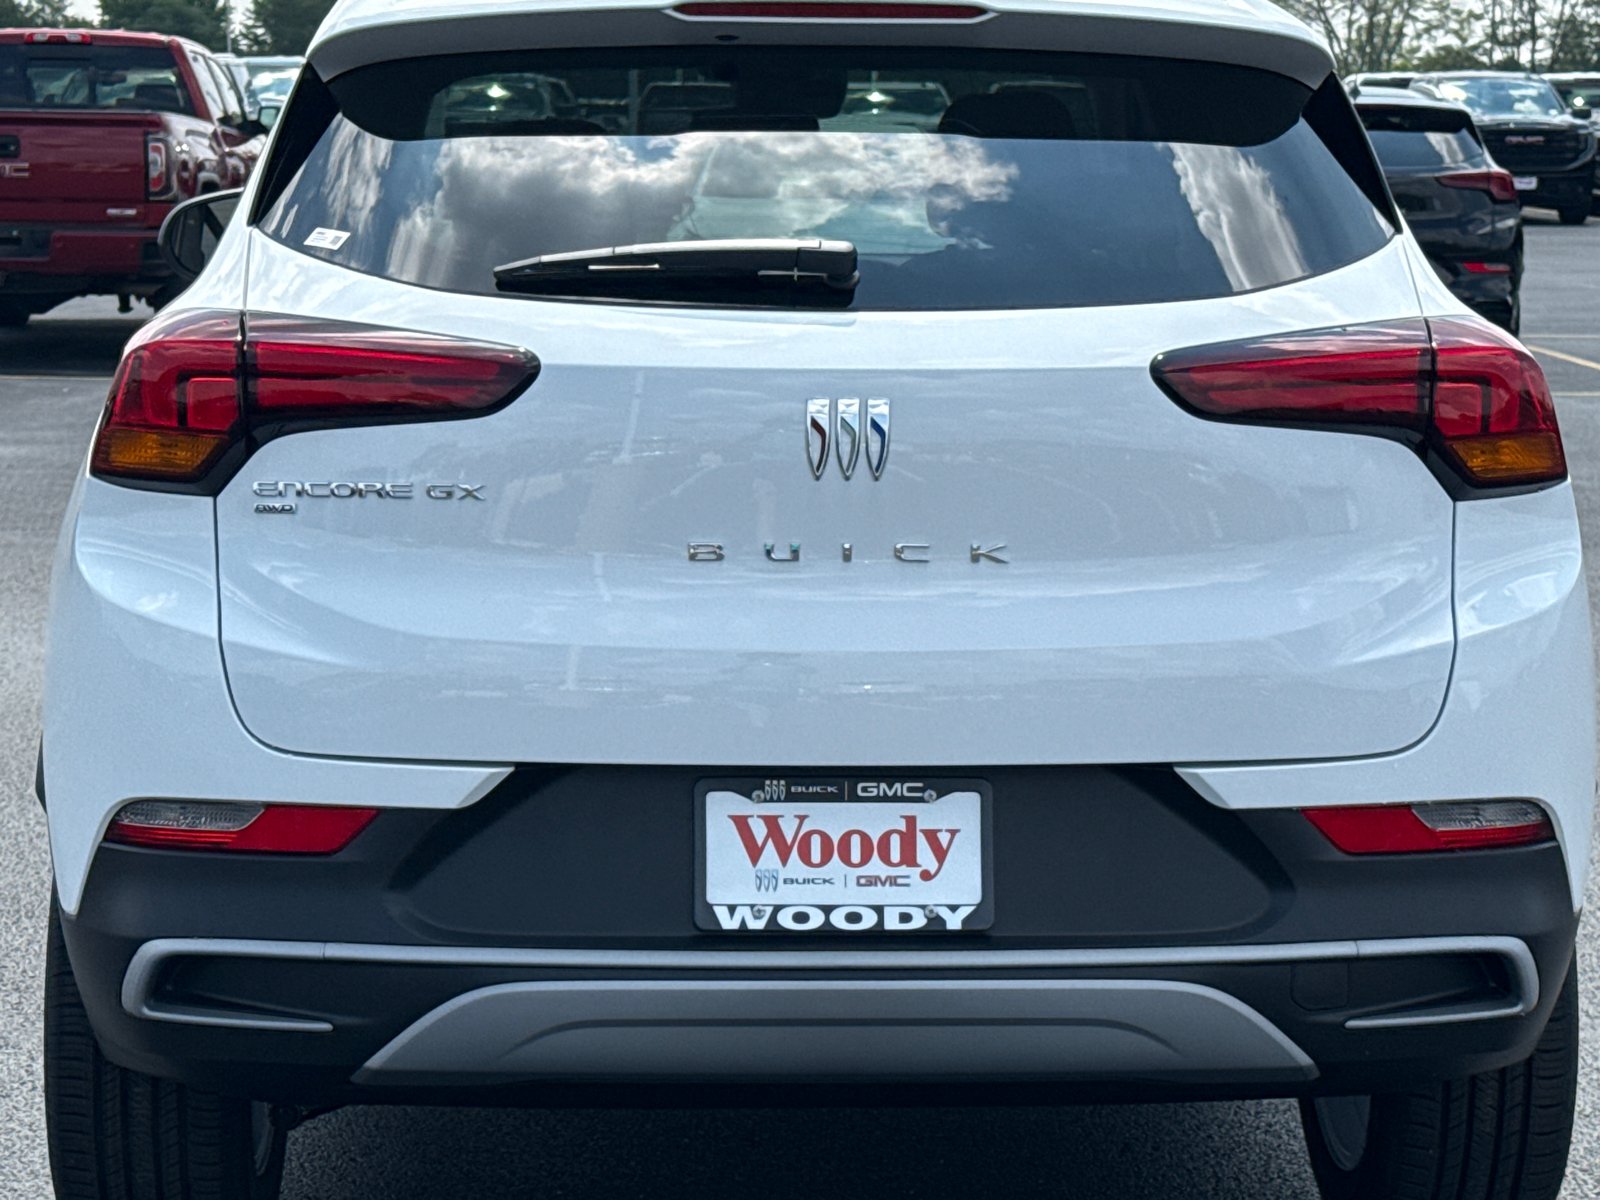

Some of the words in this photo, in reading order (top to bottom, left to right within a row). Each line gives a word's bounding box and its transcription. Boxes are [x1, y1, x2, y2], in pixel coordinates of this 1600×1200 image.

[252, 480, 413, 500] ENCORE
[425, 482, 486, 501] GX
[254, 503, 295, 514] AWD
[688, 542, 1010, 564] BUICK
[790, 785, 839, 794] BUICK
[856, 782, 925, 797] GMC
[727, 814, 962, 882] Woody
[782, 876, 836, 886] BUICK
[855, 874, 911, 888] GMC
[711, 905, 978, 931] WOODY
